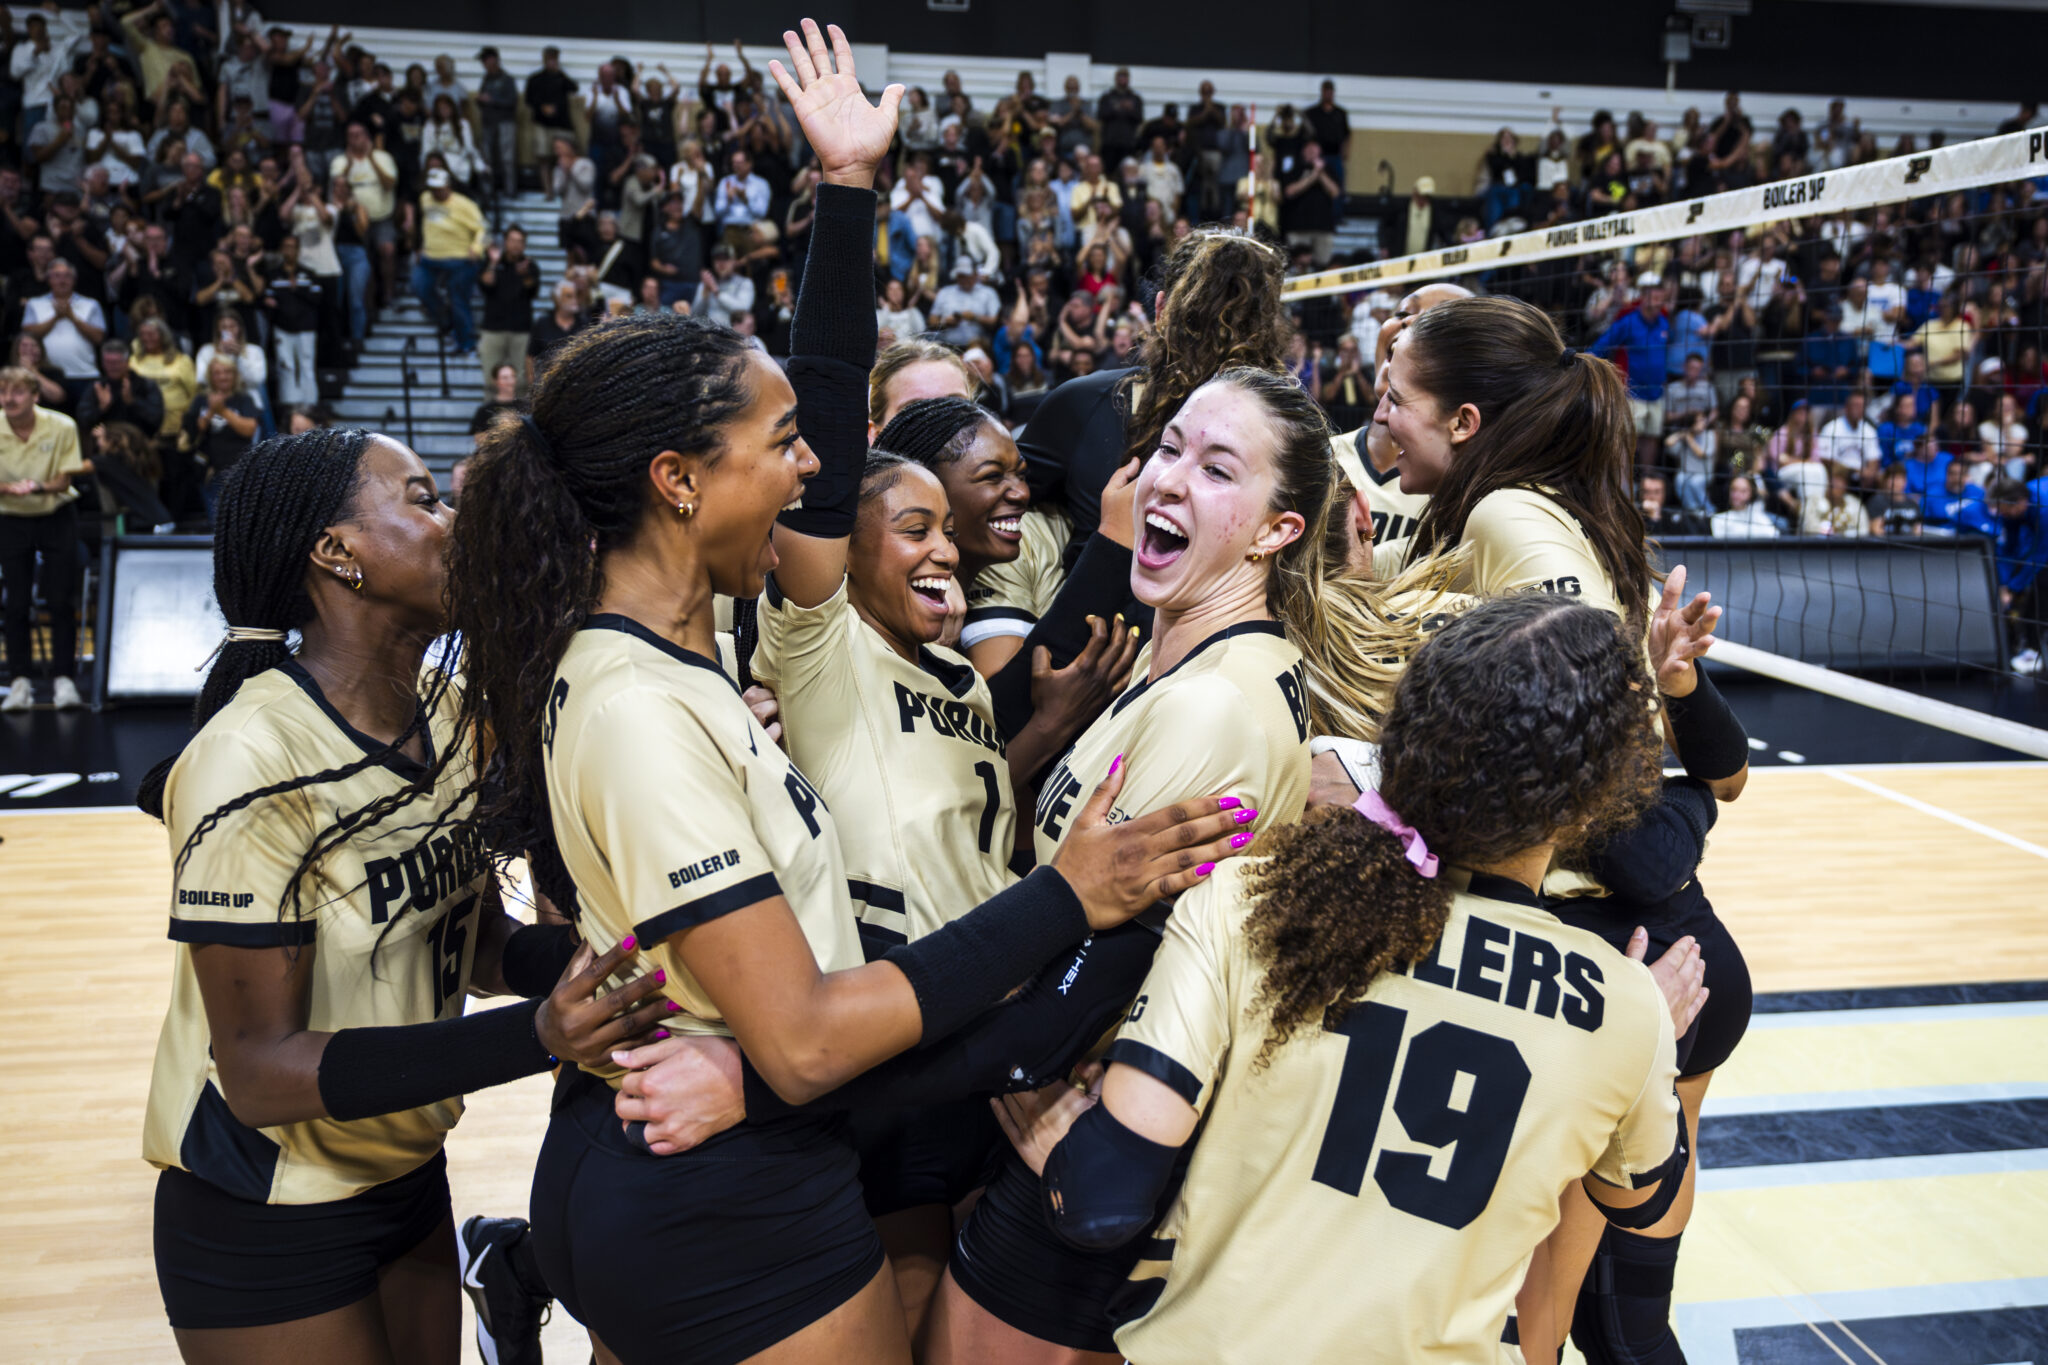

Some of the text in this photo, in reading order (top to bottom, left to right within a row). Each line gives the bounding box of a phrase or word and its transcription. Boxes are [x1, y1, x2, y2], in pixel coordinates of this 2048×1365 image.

[1763, 177, 1826, 209] BOILER UP
[1582, 217, 1635, 241] VOLLEYBALL
[974, 760, 1000, 854] 1
[667, 848, 741, 889] BOILER UP
[179, 889, 254, 908] BOILER UP
[427, 892, 480, 1019] 15
[1057, 956, 1084, 995] HEX
[1388, 914, 1605, 1033] LERS
[1312, 1000, 1532, 1230] 19
